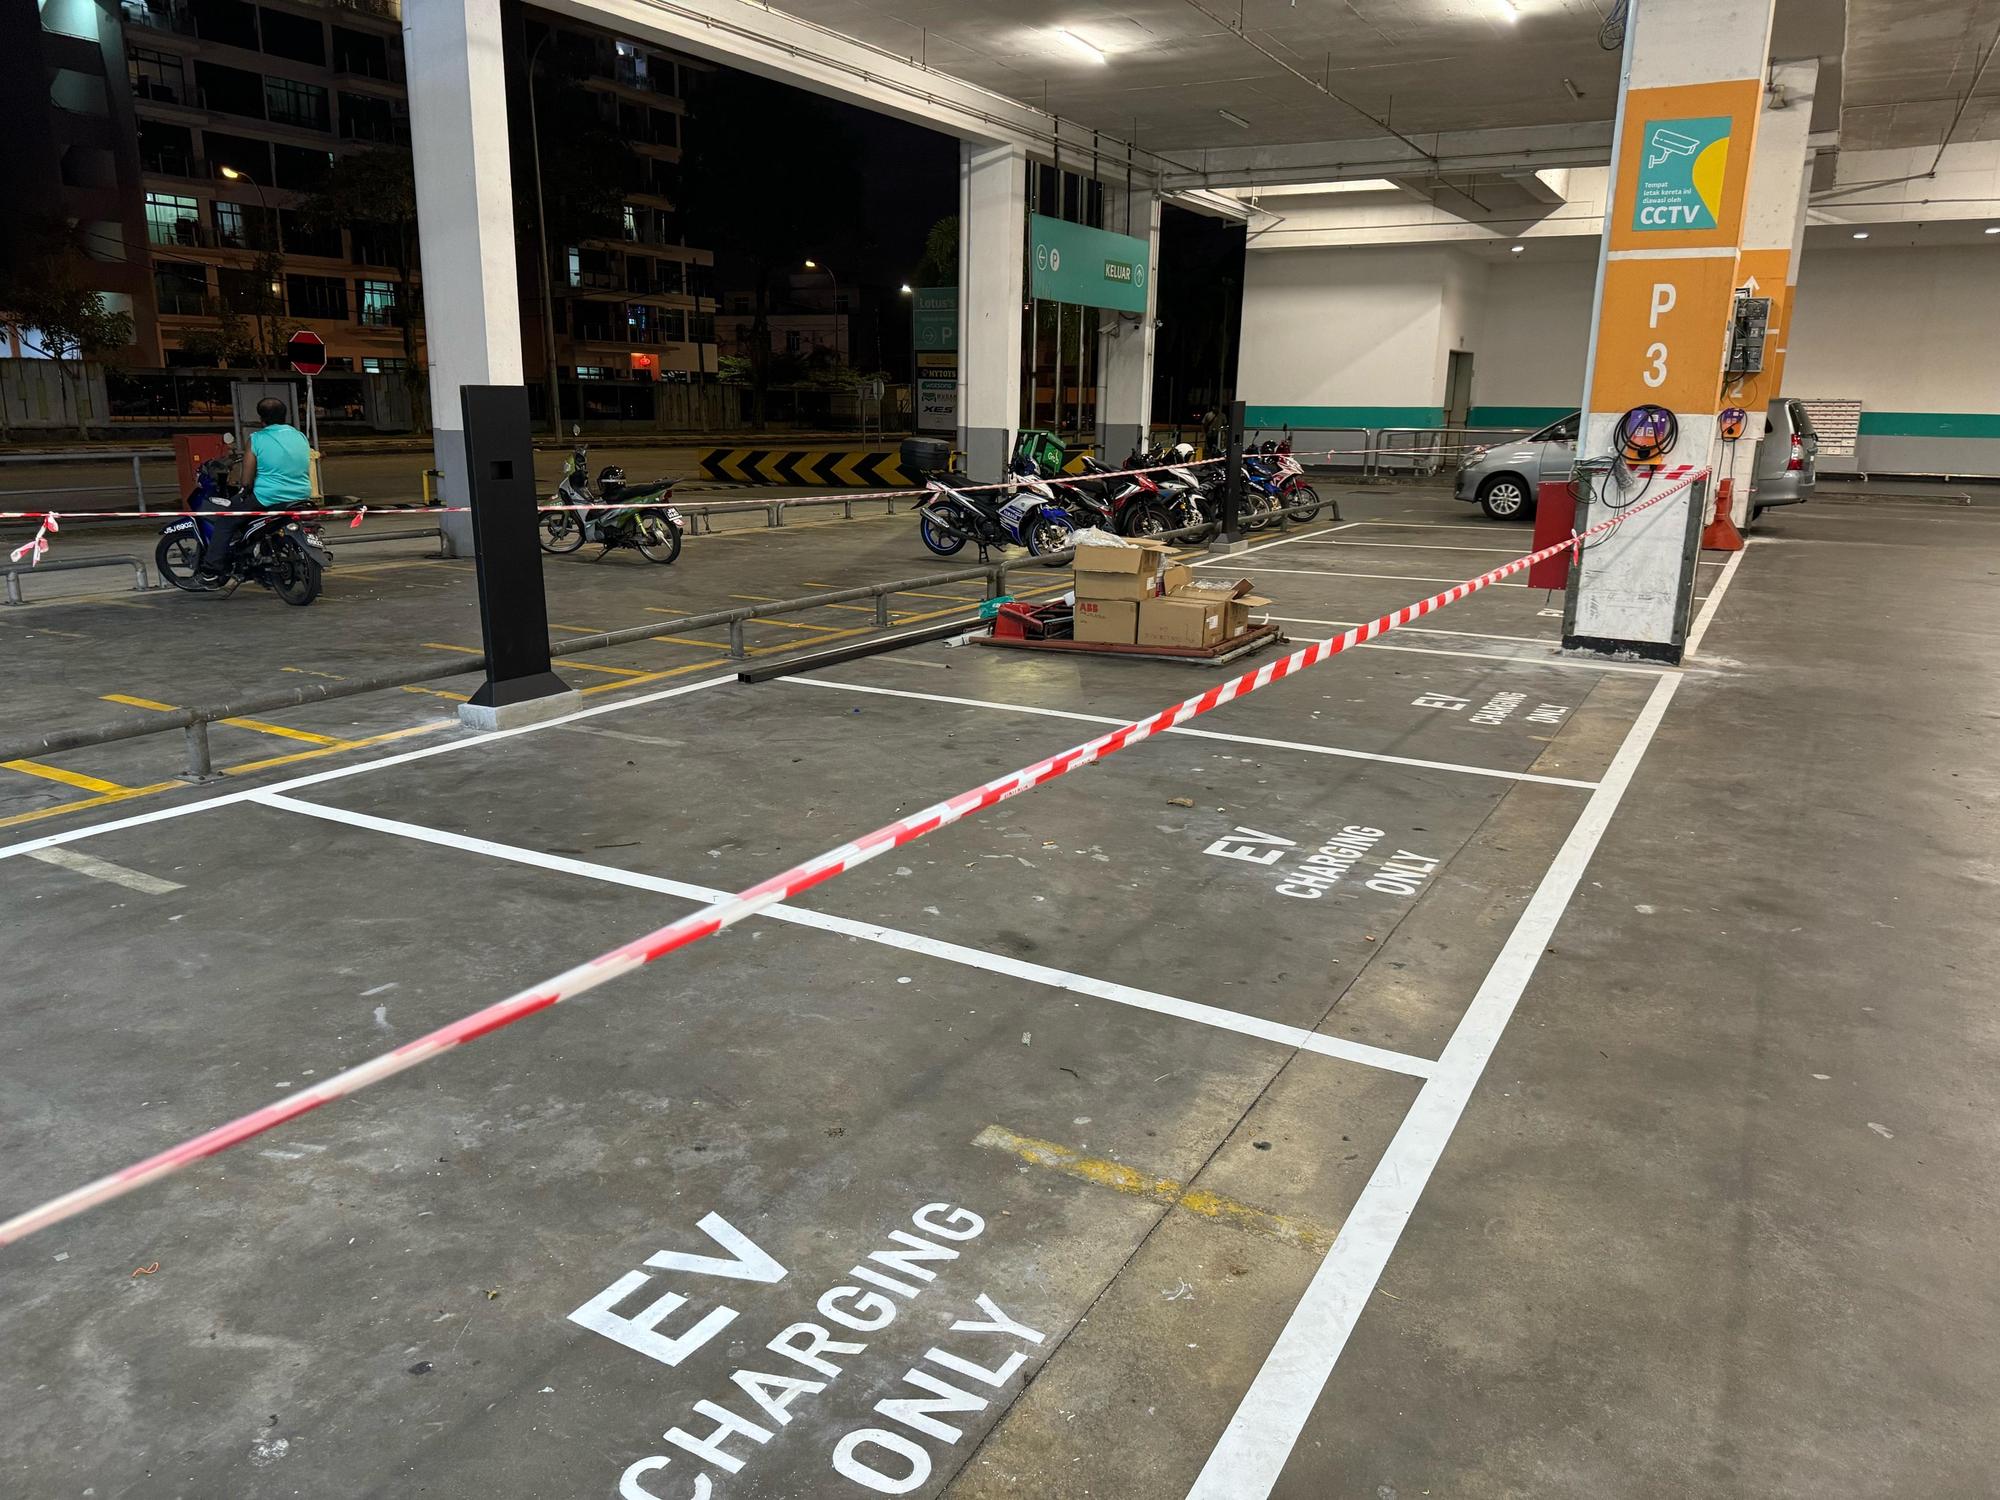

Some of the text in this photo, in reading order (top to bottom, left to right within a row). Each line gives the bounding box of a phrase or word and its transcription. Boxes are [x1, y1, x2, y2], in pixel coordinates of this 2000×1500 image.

[1640, 205, 1700, 225] CCTV
[1105, 263, 1131, 281] KELUAR
[1649, 284, 1676, 328] P
[942, 326, 953, 345] P
[1643, 342, 1668, 387] 3
[1079, 603, 1098, 613] ABB
[1410, 692, 1472, 711] EV
[1468, 691, 1528, 725] CHARGING
[1525, 703, 1570, 724] ONLY
[1202, 826, 1297, 866] EV
[1275, 825, 1386, 899] CHARGING
[1365, 849, 1440, 896] ONLY
[566, 1210, 789, 1367] EV
[618, 1202, 986, 1500] CHARGING
[832, 1293, 1046, 1495] ONLY
